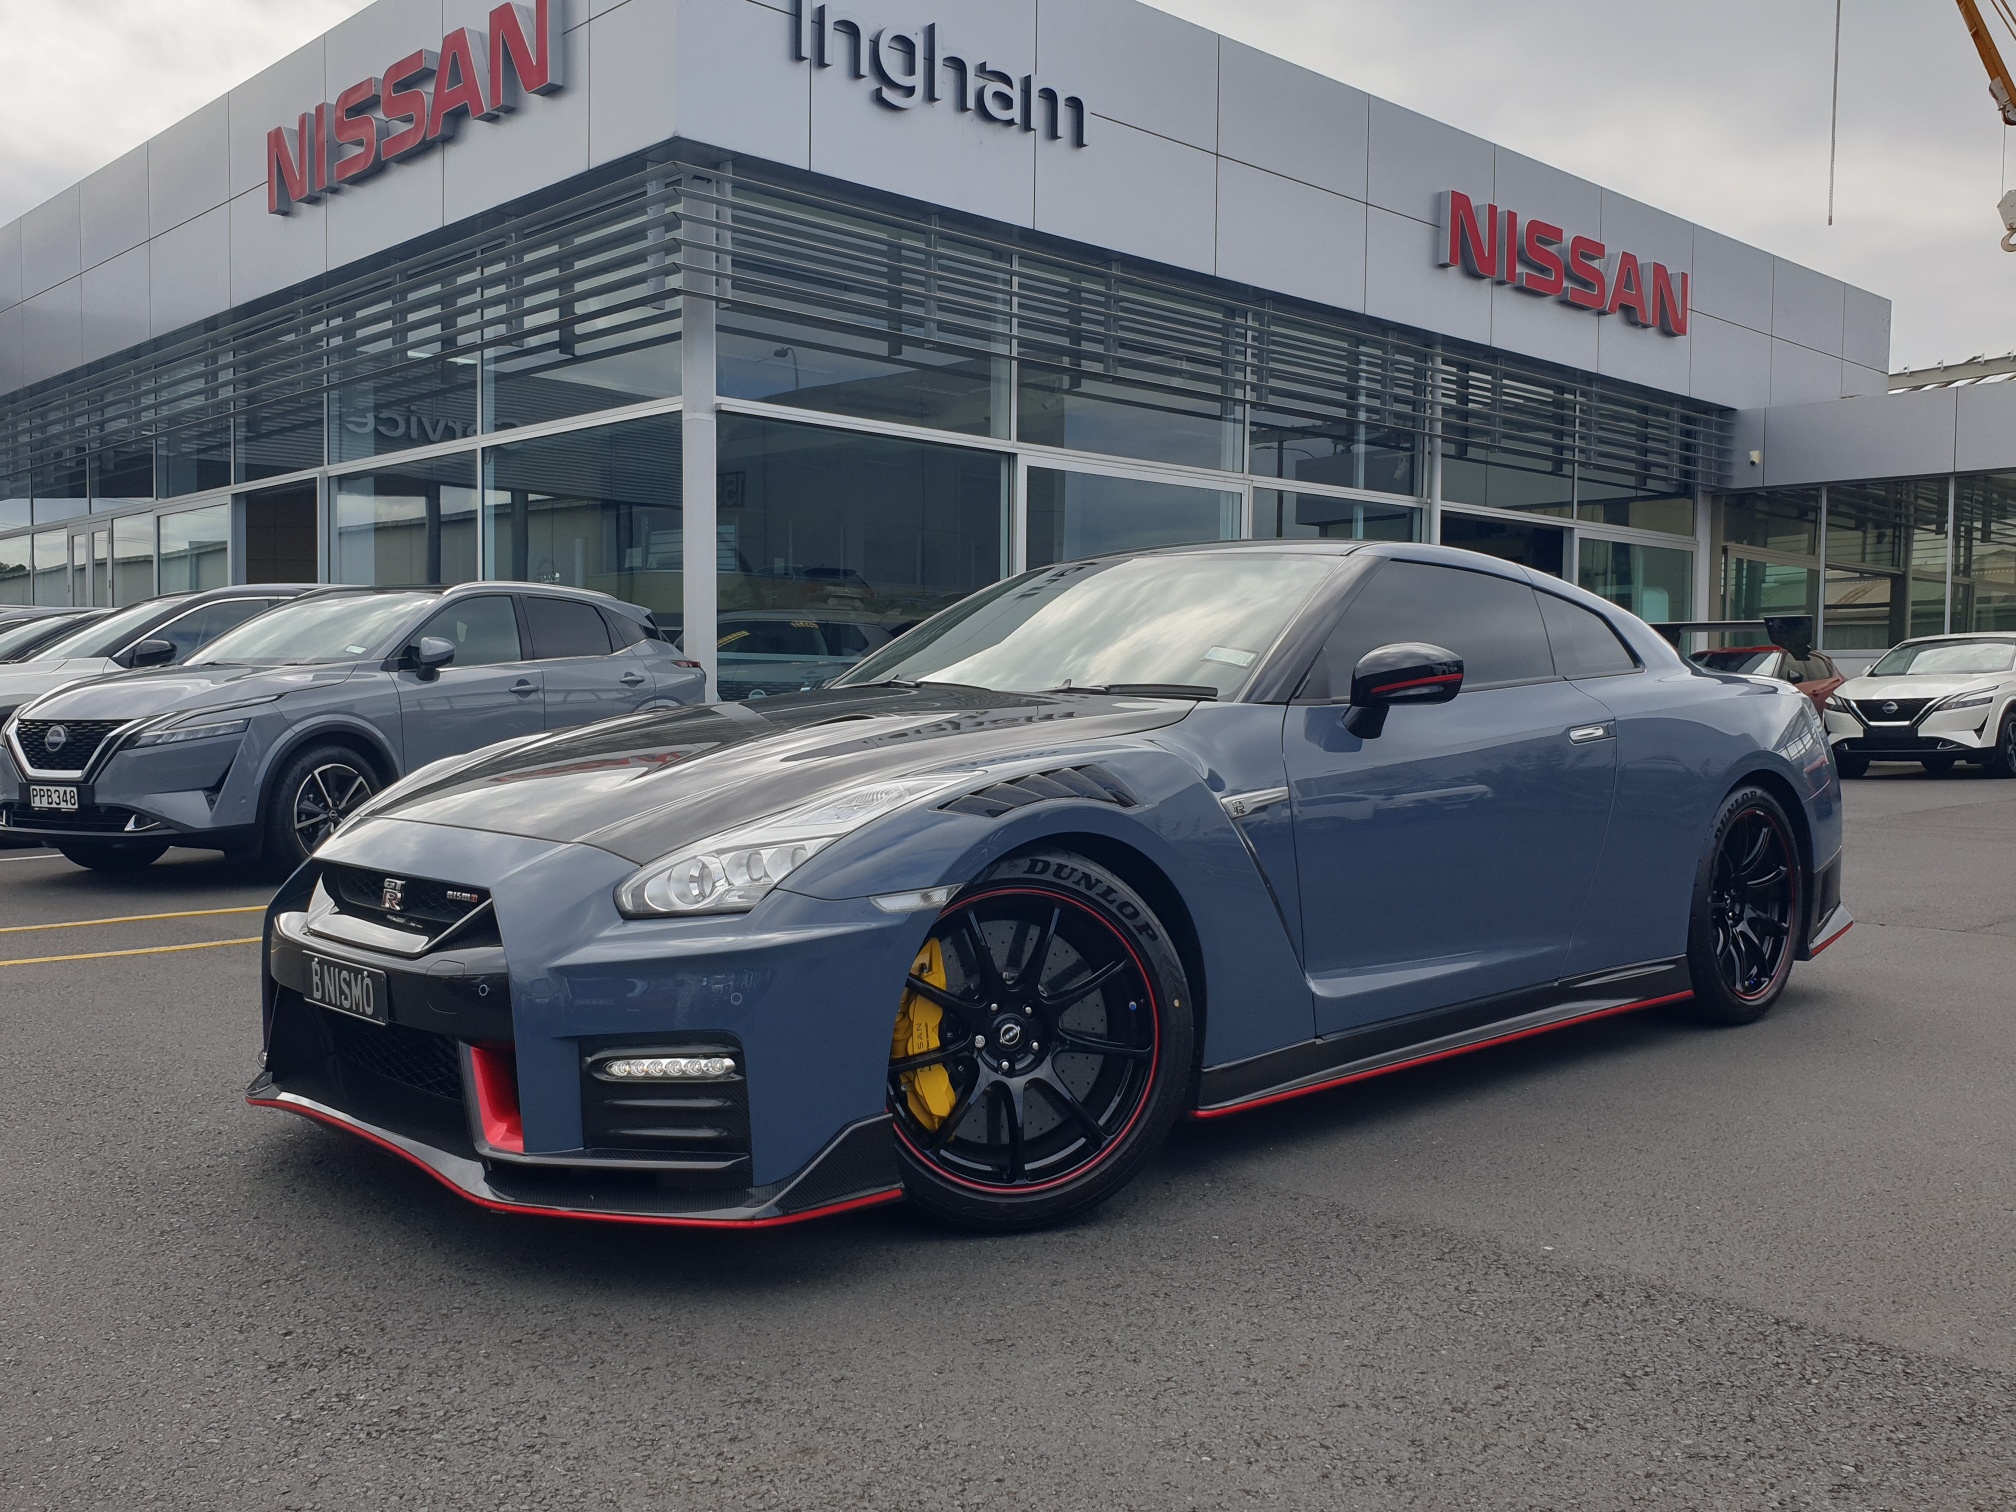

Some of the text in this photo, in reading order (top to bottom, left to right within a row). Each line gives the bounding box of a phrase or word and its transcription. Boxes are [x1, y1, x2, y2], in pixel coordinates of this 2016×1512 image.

[267, 0, 551, 215] NISSAN
[795, 0, 1090, 147] Ingham
[1447, 189, 1689, 337] NISSAN
[31, 787, 77, 807] PPB348
[1022, 858, 1159, 942] DUNLOP
[311, 961, 374, 1016] B NISMO
